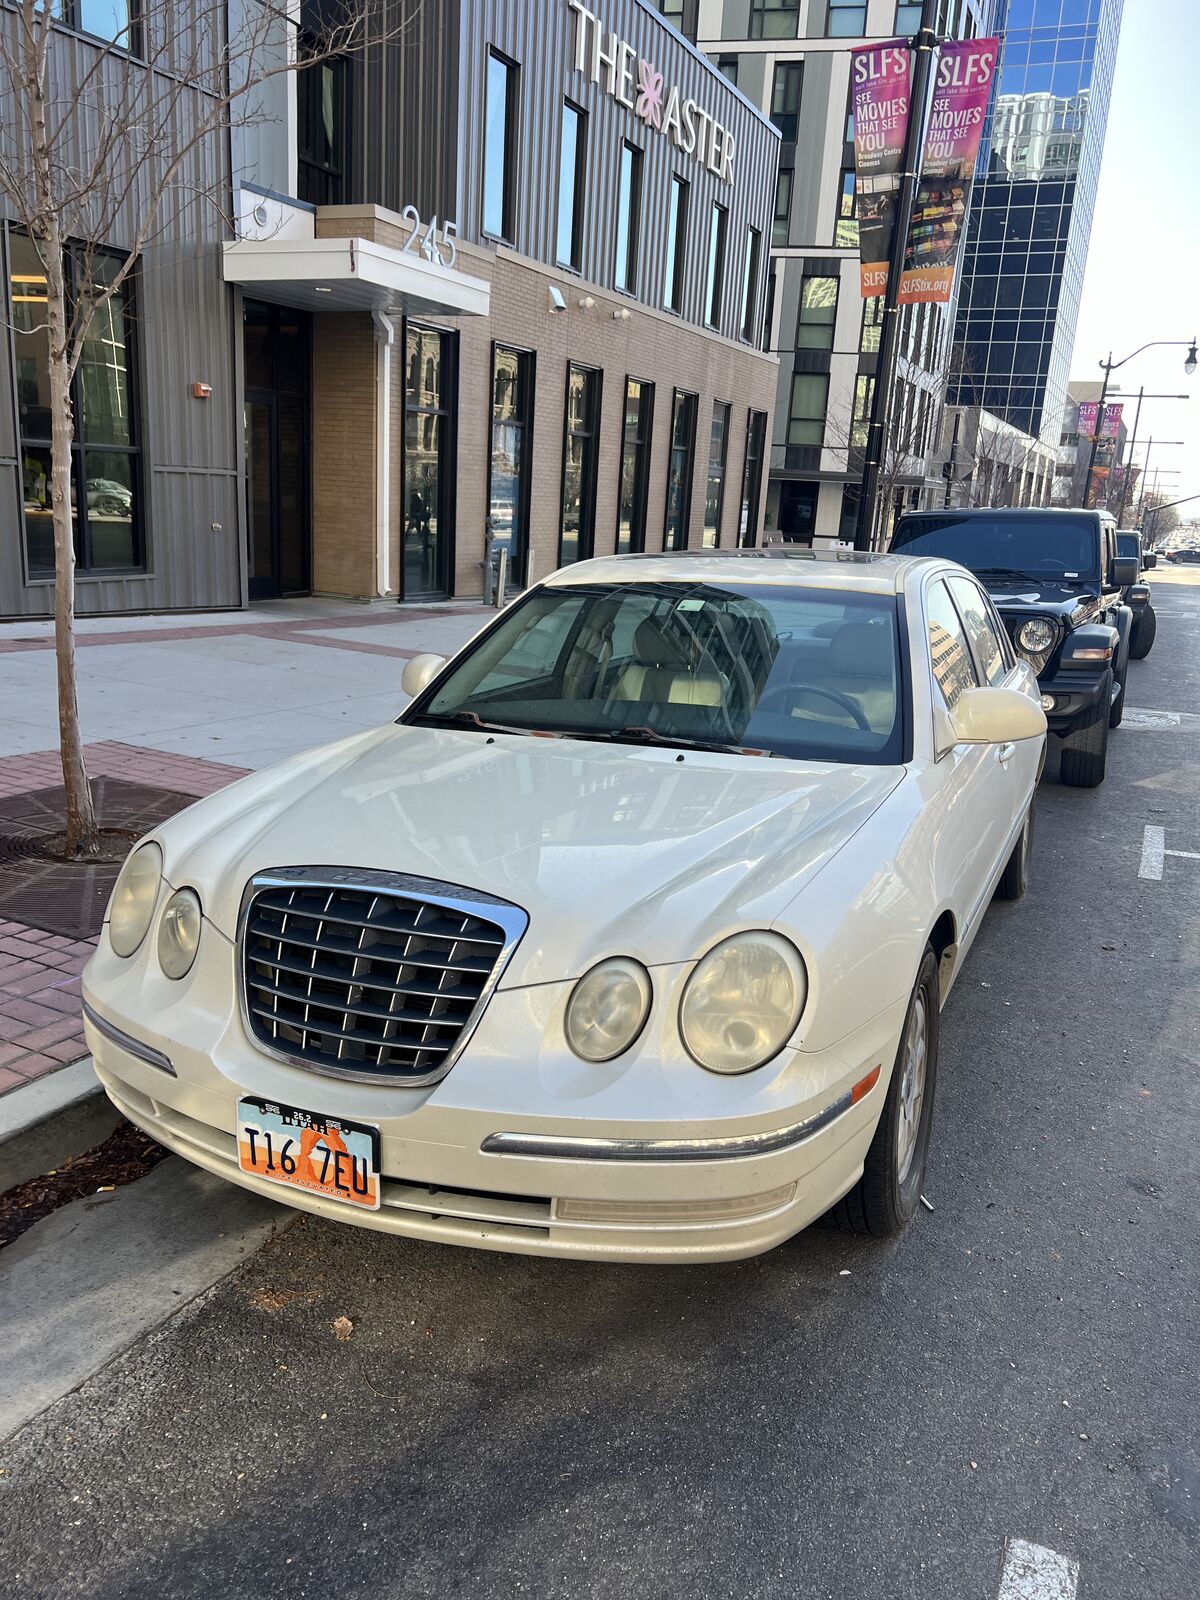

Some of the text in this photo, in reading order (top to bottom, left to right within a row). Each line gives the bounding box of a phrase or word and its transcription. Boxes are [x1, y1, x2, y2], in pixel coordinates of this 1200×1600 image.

[855, 48, 907, 84] SLFS
[937, 53, 993, 87] SLFS
[569, 0, 736, 187] THE ASTER
[856, 91, 872, 105] SEE
[857, 97, 908, 122] MOVIES
[933, 98, 951, 112] SEE
[857, 116, 898, 134] THAT SEE
[931, 106, 982, 129] MOVIES
[857, 131, 886, 152] YOU
[929, 126, 969, 142] THAT SEE
[858, 151, 884, 161] Broadway
[927, 141, 955, 159] YOU
[858, 159, 881, 168] Cinemas
[924, 159, 949, 168] Broadway
[400, 204, 458, 269] 245
[863, 271, 888, 288] SLFS
[901, 277, 949, 294] SLFStix.org
[1080, 405, 1096, 415] SLFS
[1105, 407, 1122, 416] SLFS
[293, 1111, 312, 1123] 26.2
[244, 1127, 368, 1195] T16 7EU
